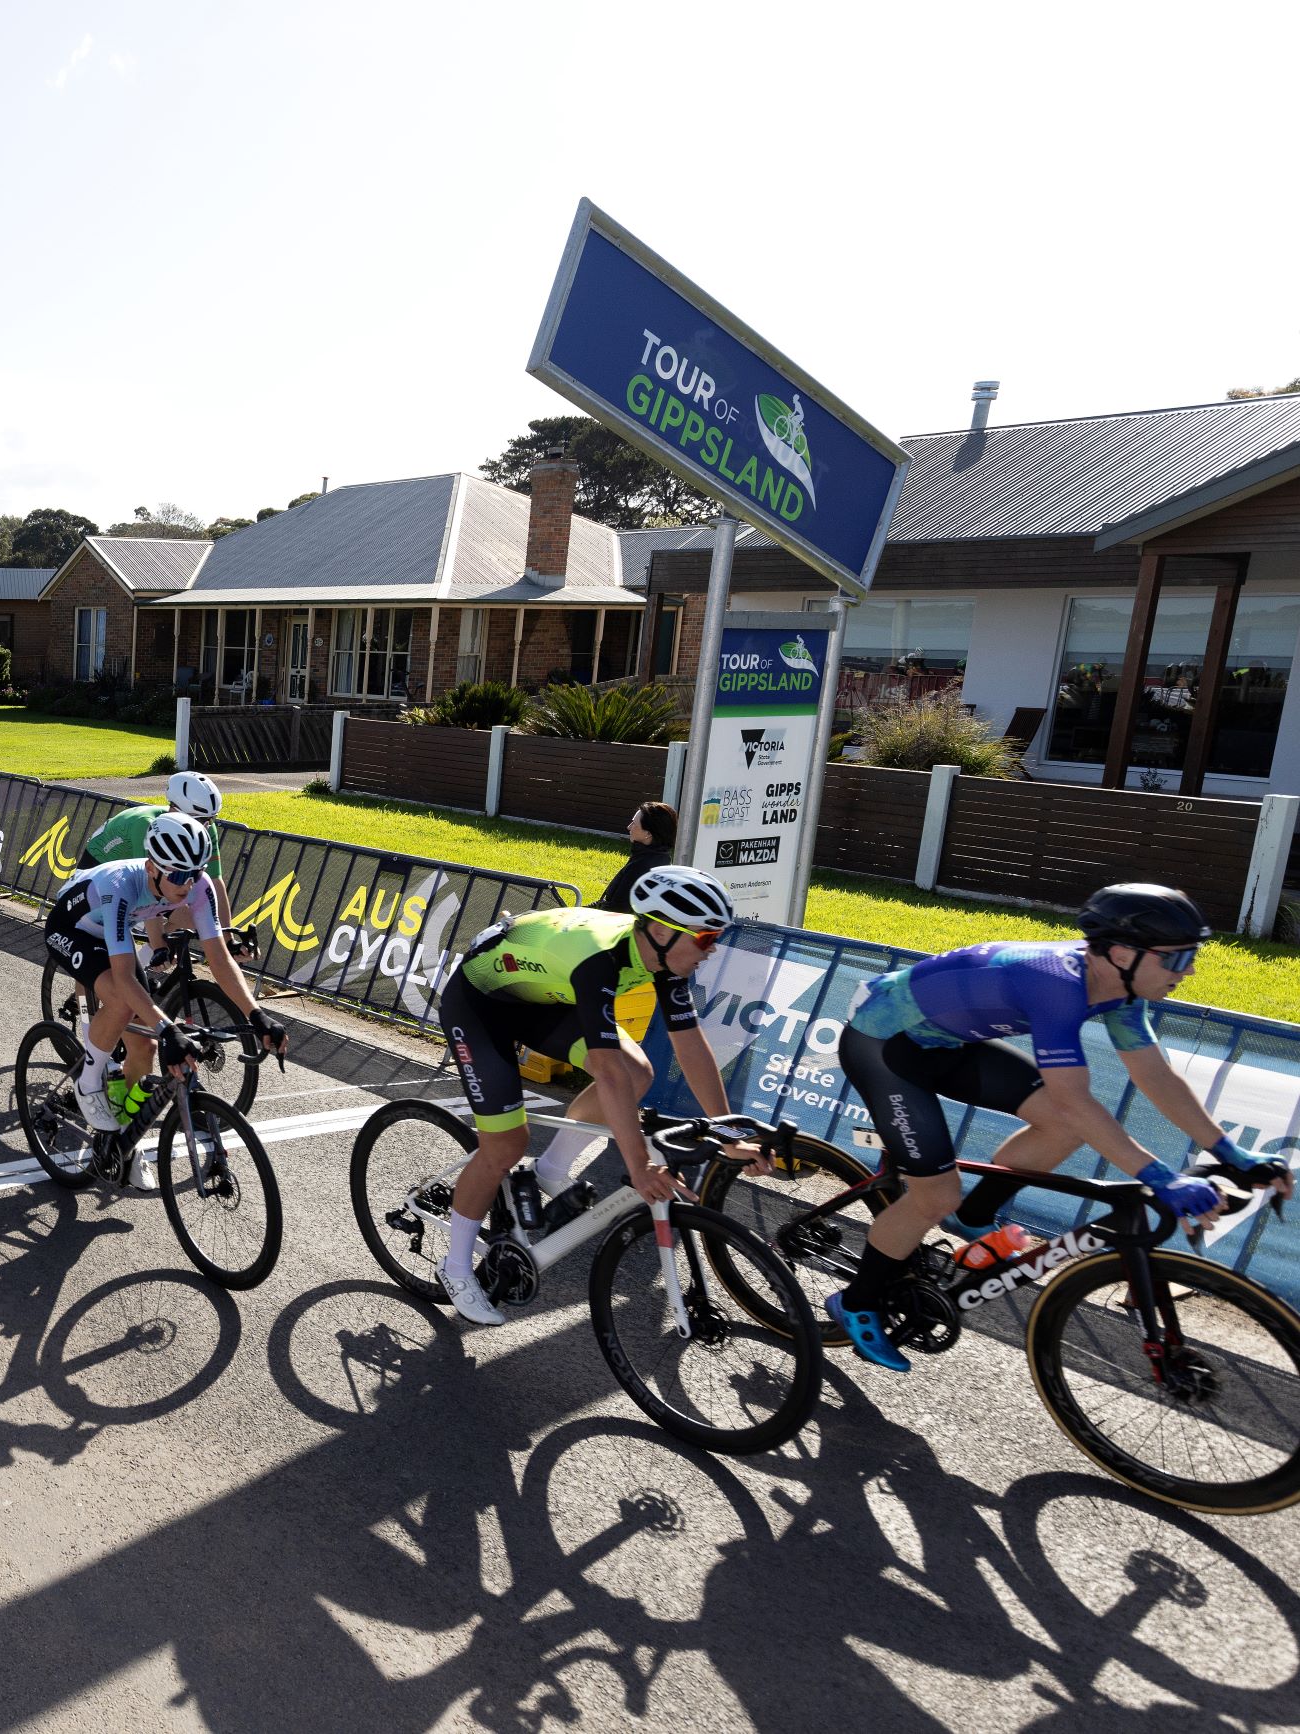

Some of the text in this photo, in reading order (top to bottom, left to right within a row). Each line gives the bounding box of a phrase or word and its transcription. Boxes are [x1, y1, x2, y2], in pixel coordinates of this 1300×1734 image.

[641, 328, 740, 426] TOUR OF
[626, 374, 804, 522] GIPPSLAND
[721, 653, 773, 670] TOUR OF
[719, 673, 813, 692] GIPPSLAND
[742, 741, 785, 752] VICTORIA
[723, 789, 754, 806] BASS
[765, 782, 802, 798] GIPPS
[761, 794, 802, 809] wonder
[721, 806, 750, 819] COAST
[761, 808, 798, 825] LAND
[741, 839, 777, 849] PAKENHAM
[739, 848, 777, 864] MAZDA
[650, 873, 678, 888] KASK
[747, 880, 772, 888] Anderson
[339, 885, 428, 936] AUS
[328, 924, 464, 989] CYCLI
[695, 982, 845, 1054] VICTO
[765, 1053, 836, 1088] State
[758, 1073, 872, 1125] Governm
[865, 1133, 872, 1146] 4
[956, 1225, 1107, 1311] cervélo
